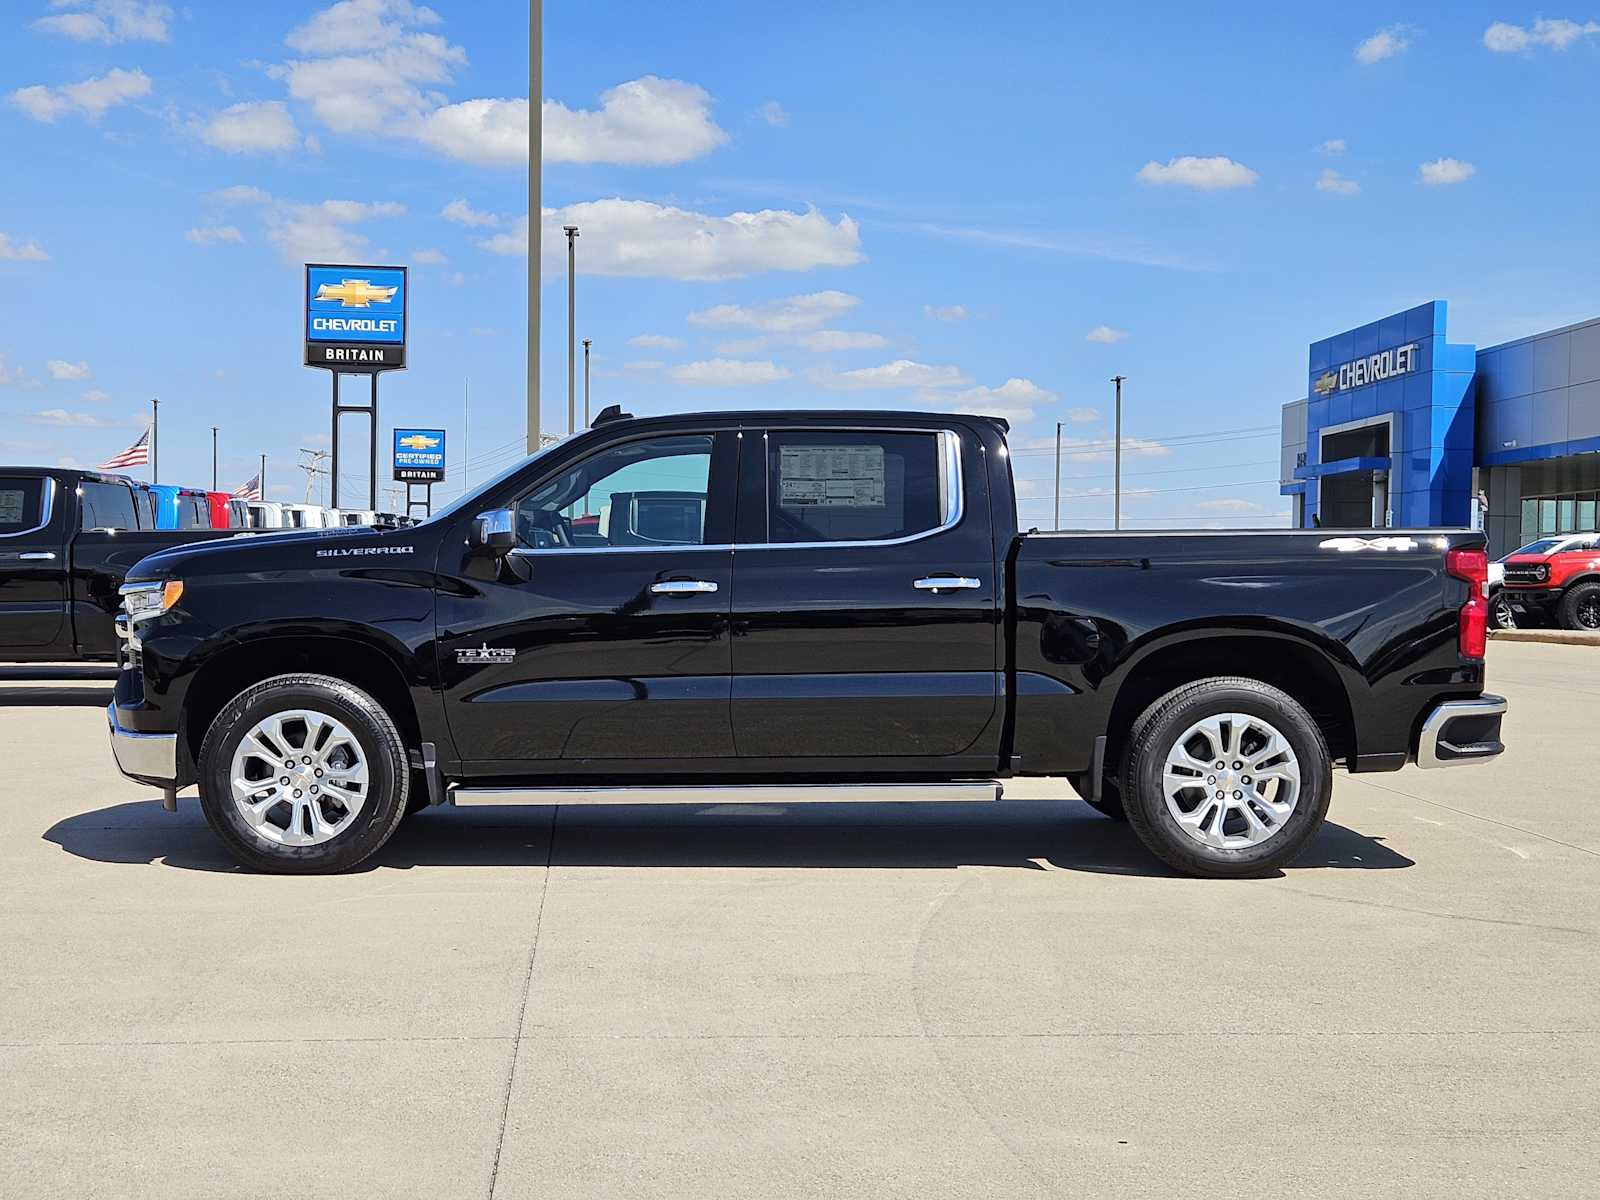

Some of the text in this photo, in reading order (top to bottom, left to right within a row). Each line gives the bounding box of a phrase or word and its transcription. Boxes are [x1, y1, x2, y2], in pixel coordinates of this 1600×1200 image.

[313, 318, 398, 332] CHEVROLET
[325, 348, 385, 361] BRITAIN
[1339, 343, 1415, 390] CHEVROLET
[400, 471, 437, 479] BRITAIN
[315, 546, 415, 558] SILVERADO
[454, 642, 517, 658] TEXAS
